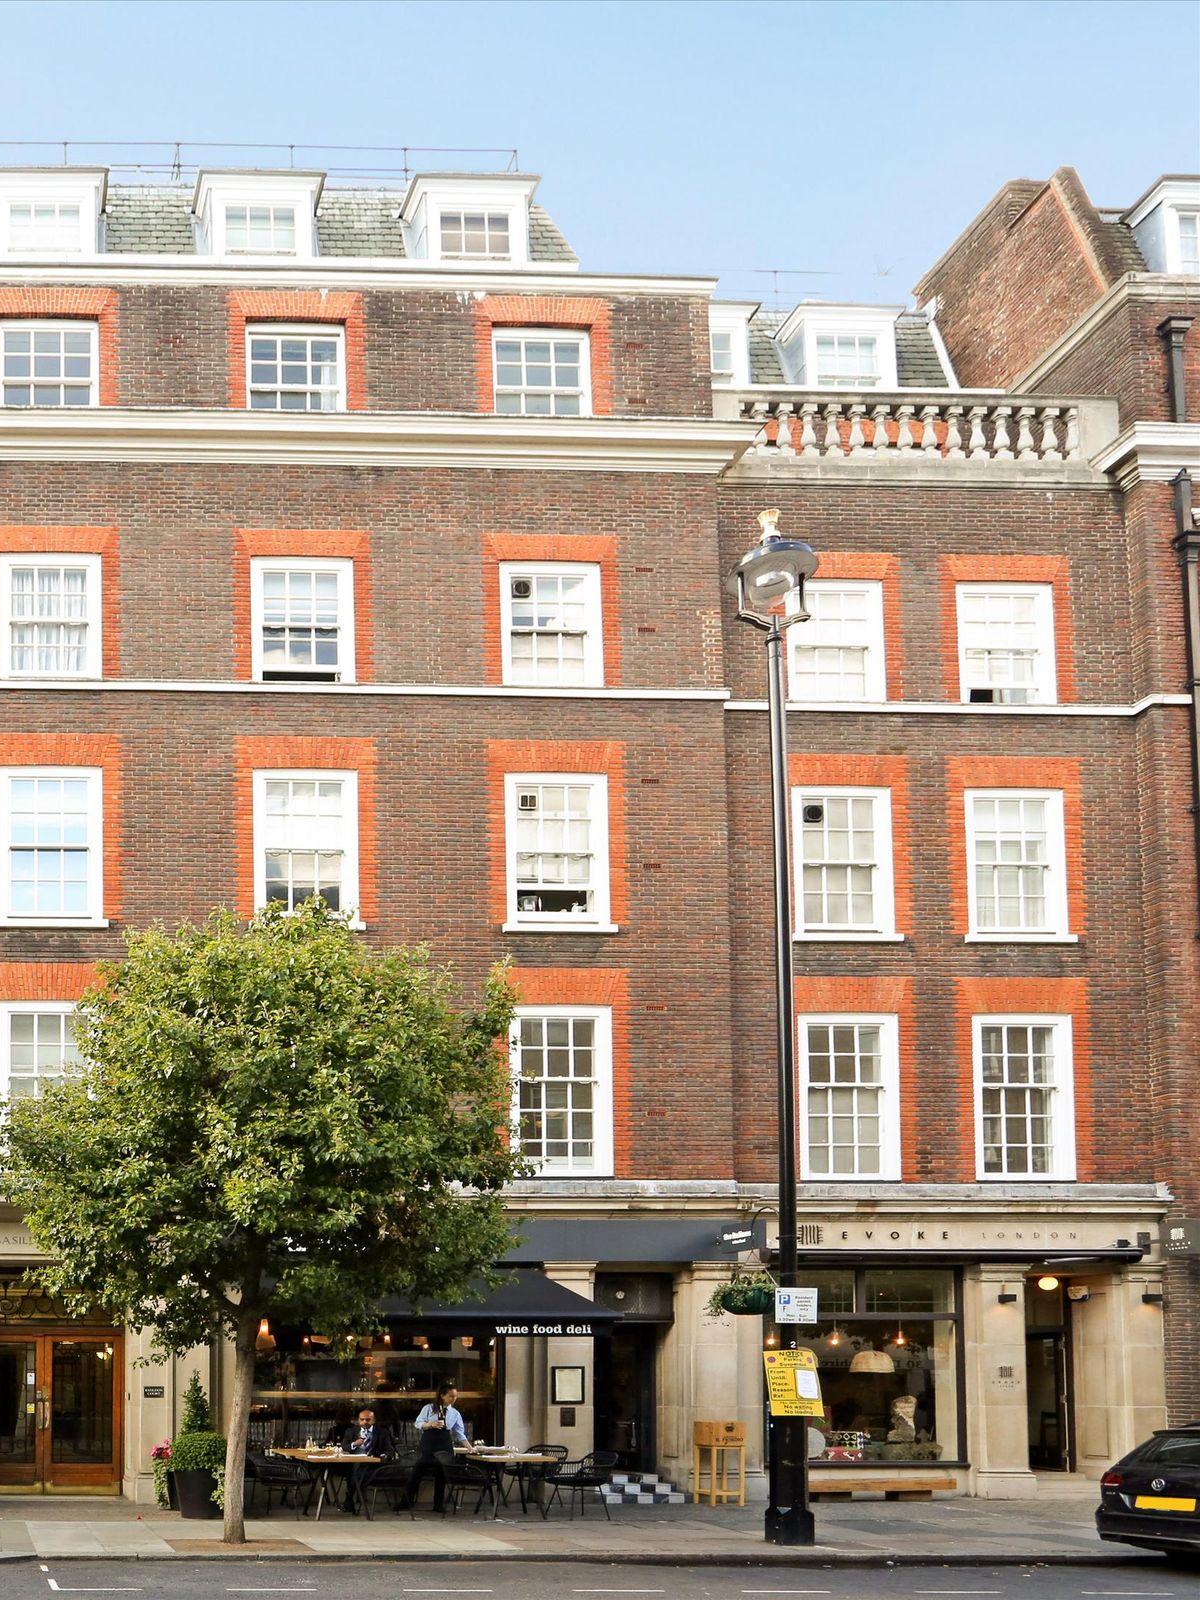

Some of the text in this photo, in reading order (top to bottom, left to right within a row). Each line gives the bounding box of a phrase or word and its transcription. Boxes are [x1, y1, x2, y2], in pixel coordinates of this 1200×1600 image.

[841, 1231, 1077, 1240] EVOKE LONDON
[495, 1323, 593, 1334] wine food deli
